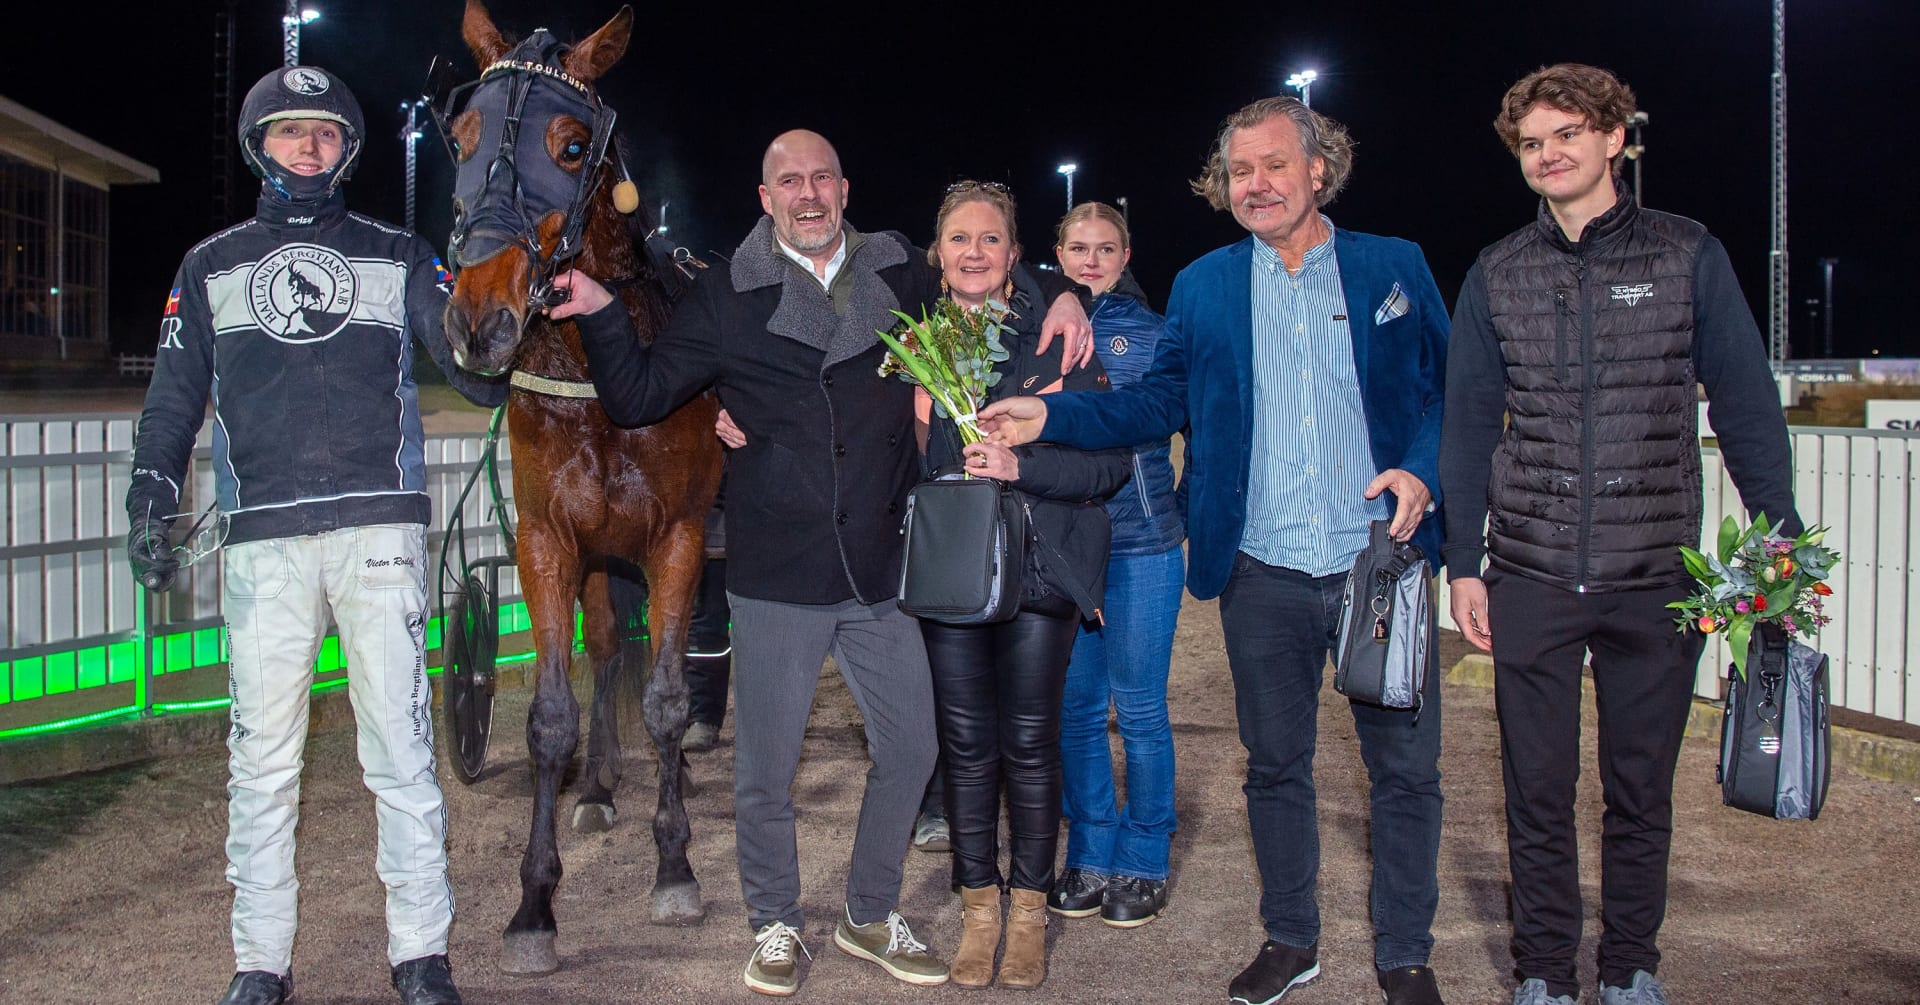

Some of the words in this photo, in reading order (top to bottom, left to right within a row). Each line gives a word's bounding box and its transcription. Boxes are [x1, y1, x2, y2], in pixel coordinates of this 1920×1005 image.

[256, 261, 280, 324] HALLANDS
[281, 250, 350, 284] BERGTJÄNST
[337, 286, 350, 305] AB
[157, 316, 185, 352] R
